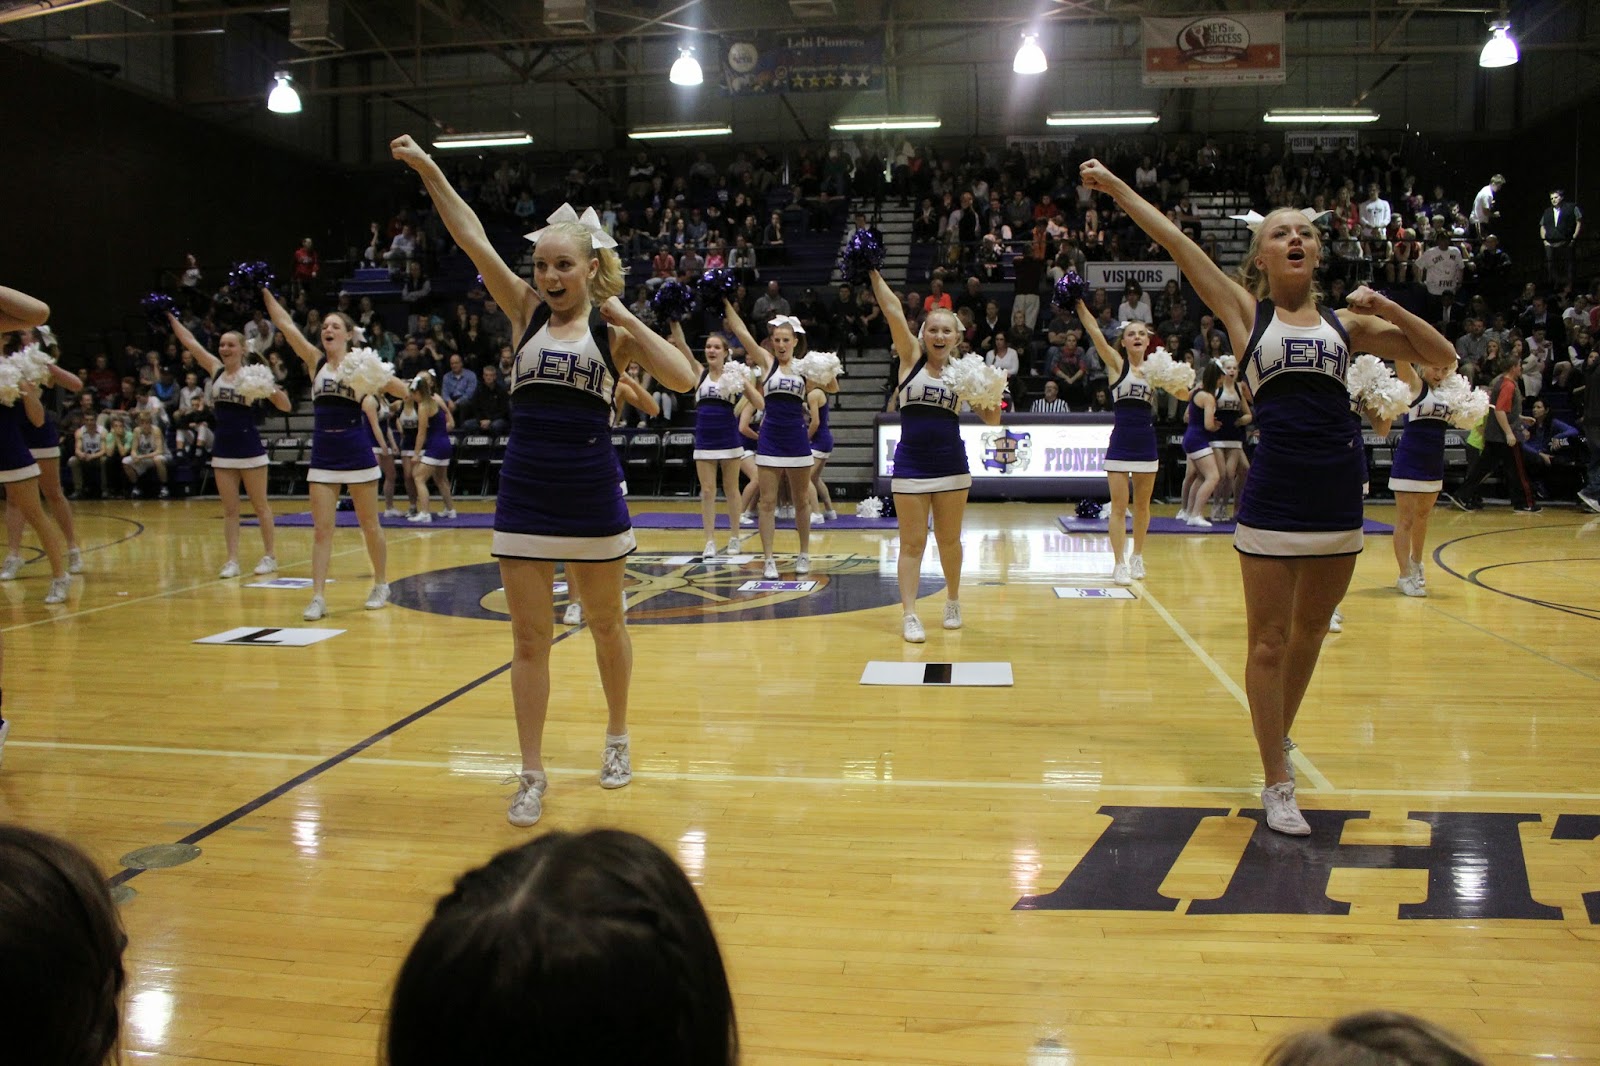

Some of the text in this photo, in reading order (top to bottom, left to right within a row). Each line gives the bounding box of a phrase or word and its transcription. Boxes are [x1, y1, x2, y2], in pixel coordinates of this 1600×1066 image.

[1207, 23, 1227, 33] KEYS
[1208, 33, 1242, 44] SUCCESS
[1103, 270, 1163, 282] VISITORS
[1252, 337, 1349, 384] LEHI
[514, 348, 606, 398] LEHI
[906, 385, 959, 410] LEHI
[1117, 384, 1153, 400] LEH
[1416, 402, 1453, 419] LEH
[1043, 447, 1108, 472] PIONEE
